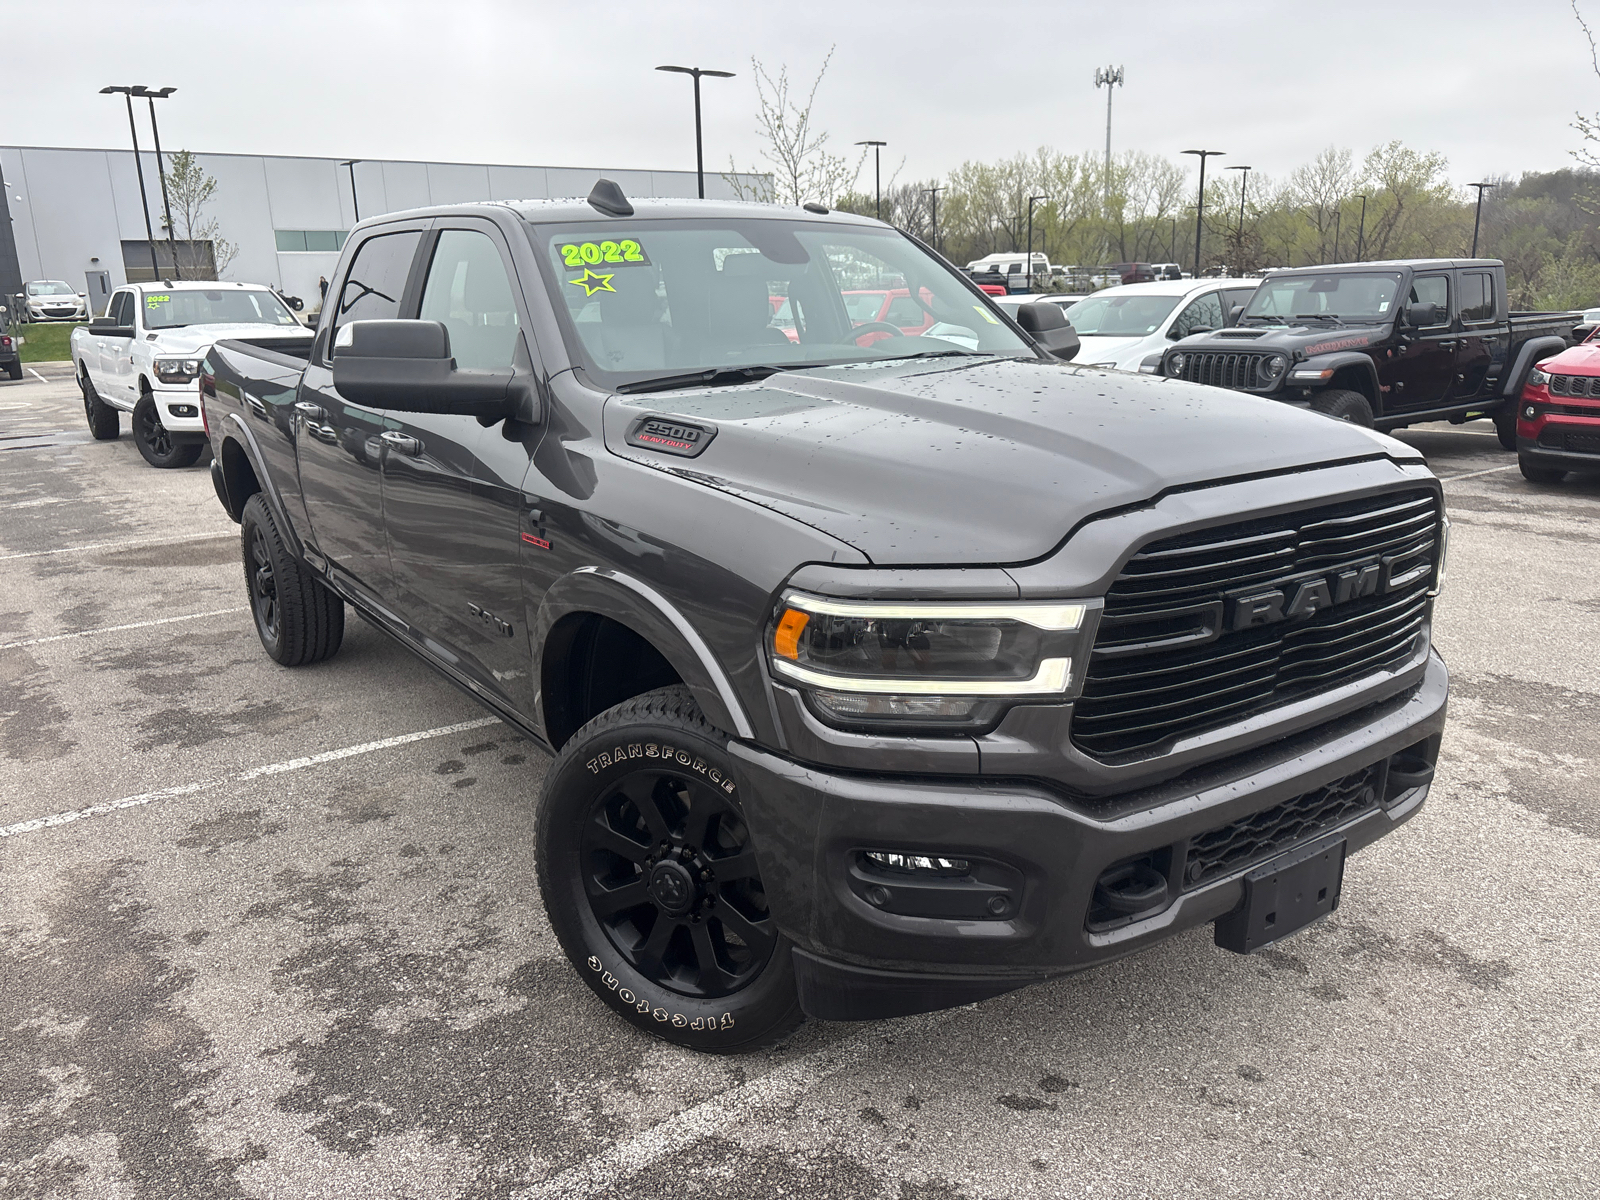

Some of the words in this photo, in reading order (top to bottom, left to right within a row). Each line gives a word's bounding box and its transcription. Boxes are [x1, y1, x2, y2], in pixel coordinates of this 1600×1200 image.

[561, 239, 644, 267] 2022
[147, 295, 170, 303] 2022
[1305, 337, 1369, 354] MOJAVE
[638, 434, 667, 445] HEAVY
[666, 440, 692, 450] DUTY
[644, 422, 699, 442] 2500
[1232, 563, 1380, 630] RAM
[586, 743, 736, 794] TRANSFORCE
